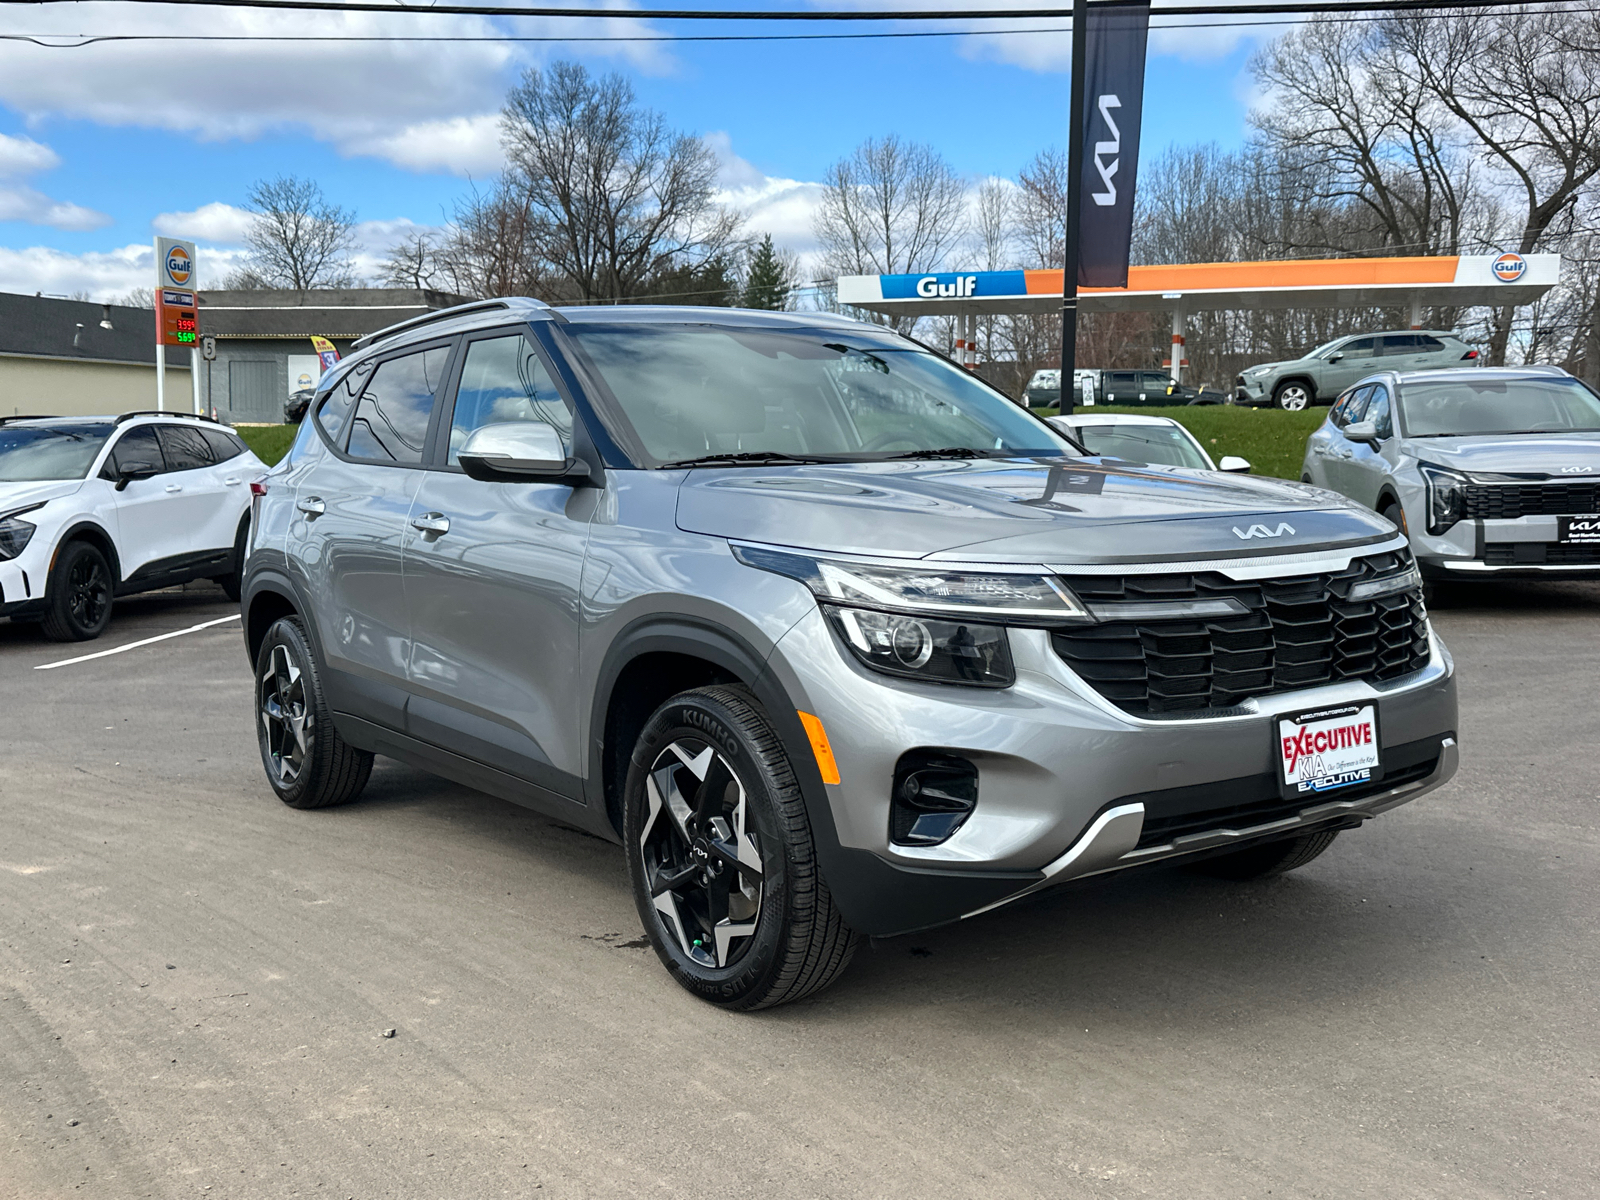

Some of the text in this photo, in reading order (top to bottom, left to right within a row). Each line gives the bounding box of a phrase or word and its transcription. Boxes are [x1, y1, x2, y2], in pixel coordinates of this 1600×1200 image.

[169, 259, 191, 272] Gulf
[1494, 262, 1524, 271] Gulf
[916, 276, 977, 297] Gulf
[207, 342, 213, 355] 5
[1232, 522, 1296, 540] KIA
[682, 709, 739, 756] KUMHO
[1282, 722, 1372, 775] EXECUTIVE
[1298, 755, 1327, 780] KIA
[1297, 769, 1371, 792] EXECUTIVE
